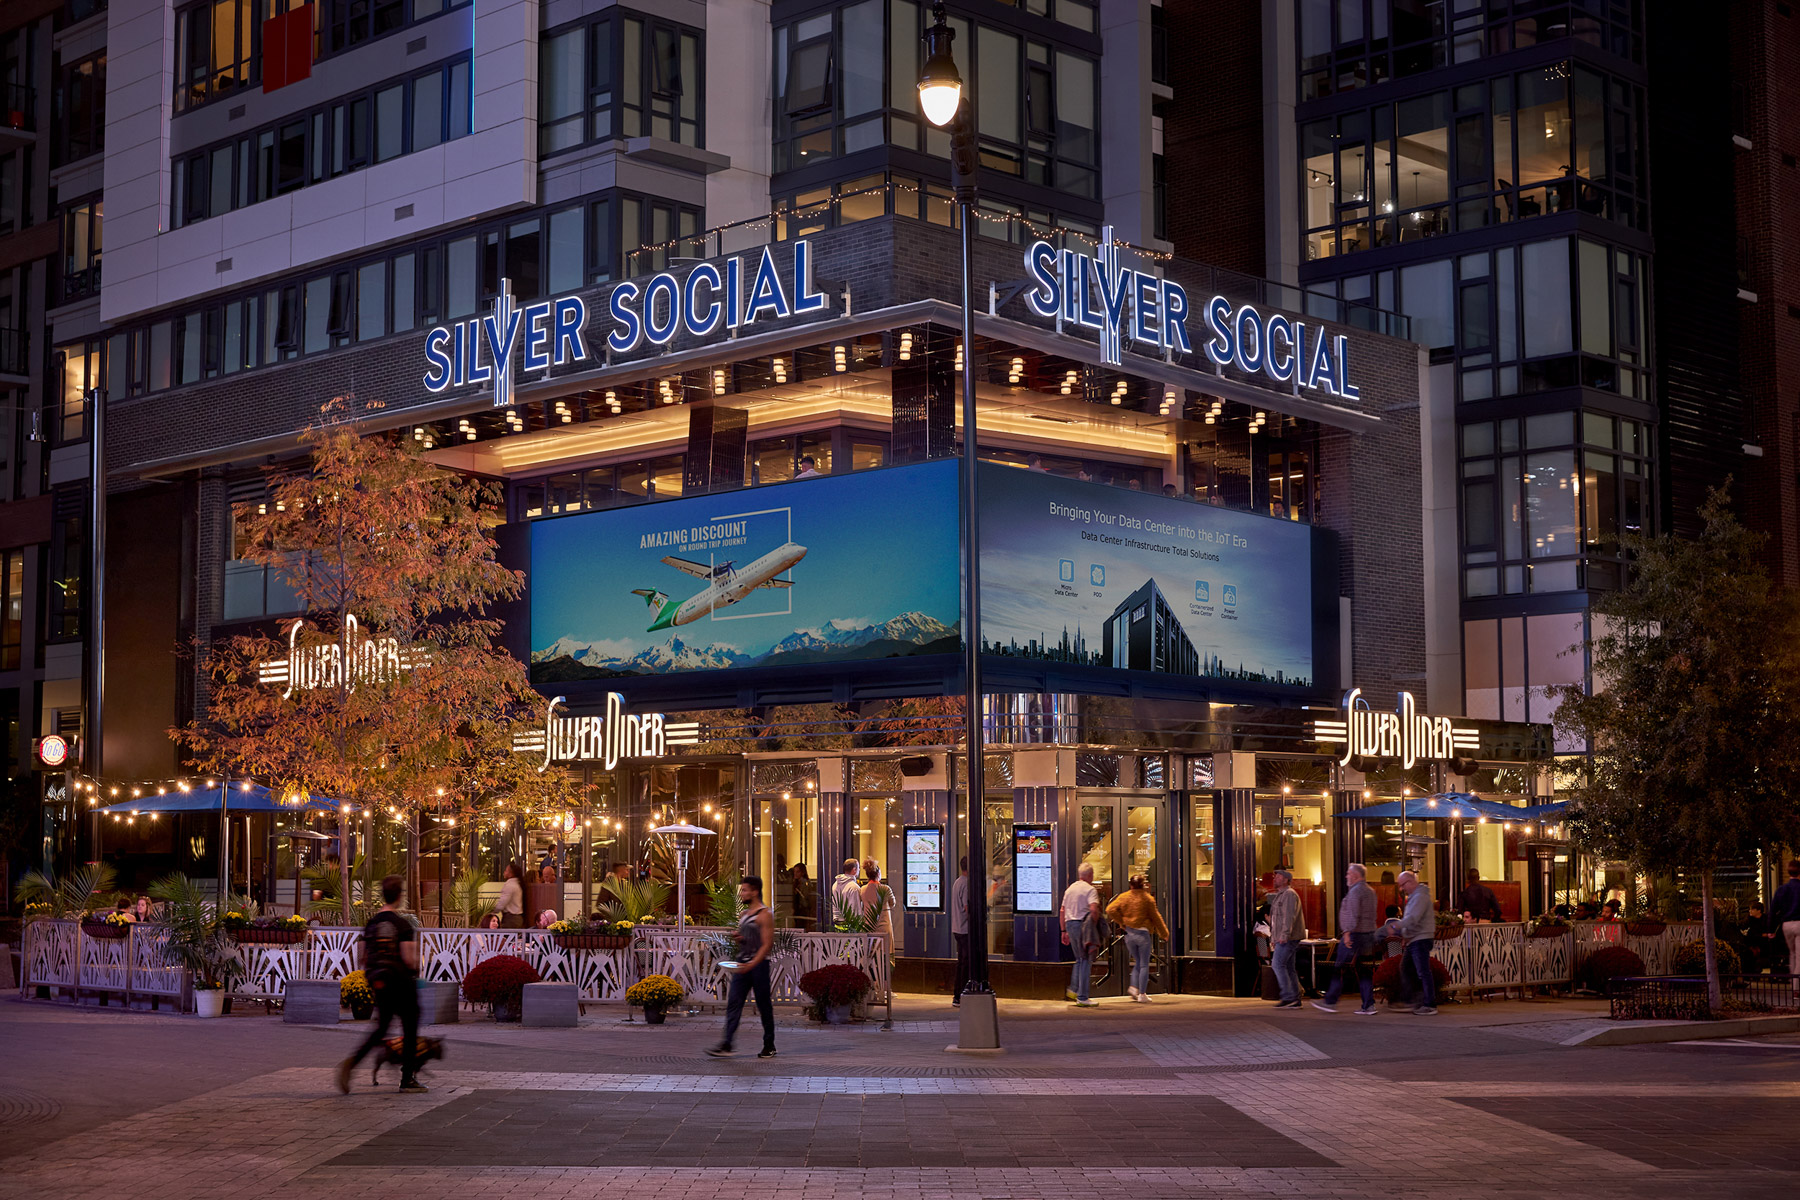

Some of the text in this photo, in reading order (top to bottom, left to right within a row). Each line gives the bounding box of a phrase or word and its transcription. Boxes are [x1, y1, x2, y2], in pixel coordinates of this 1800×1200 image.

[422, 239, 829, 406] SILVER SOCIAL
[1023, 225, 1360, 400] SILVER SOCIAL
[640, 521, 747, 549] AMAZING DISCOUNT
[678, 536, 747, 553] ON ROUND TRIP JOURNEY
[1049, 502, 1247, 548] Bringing Your Data Center into the IoT Era
[1081, 531, 1220, 562] Data Center Infrastructure Total Solutions
[538, 692, 665, 773] SILVER DINER
[1339, 687, 1454, 770] SILVER DINER
